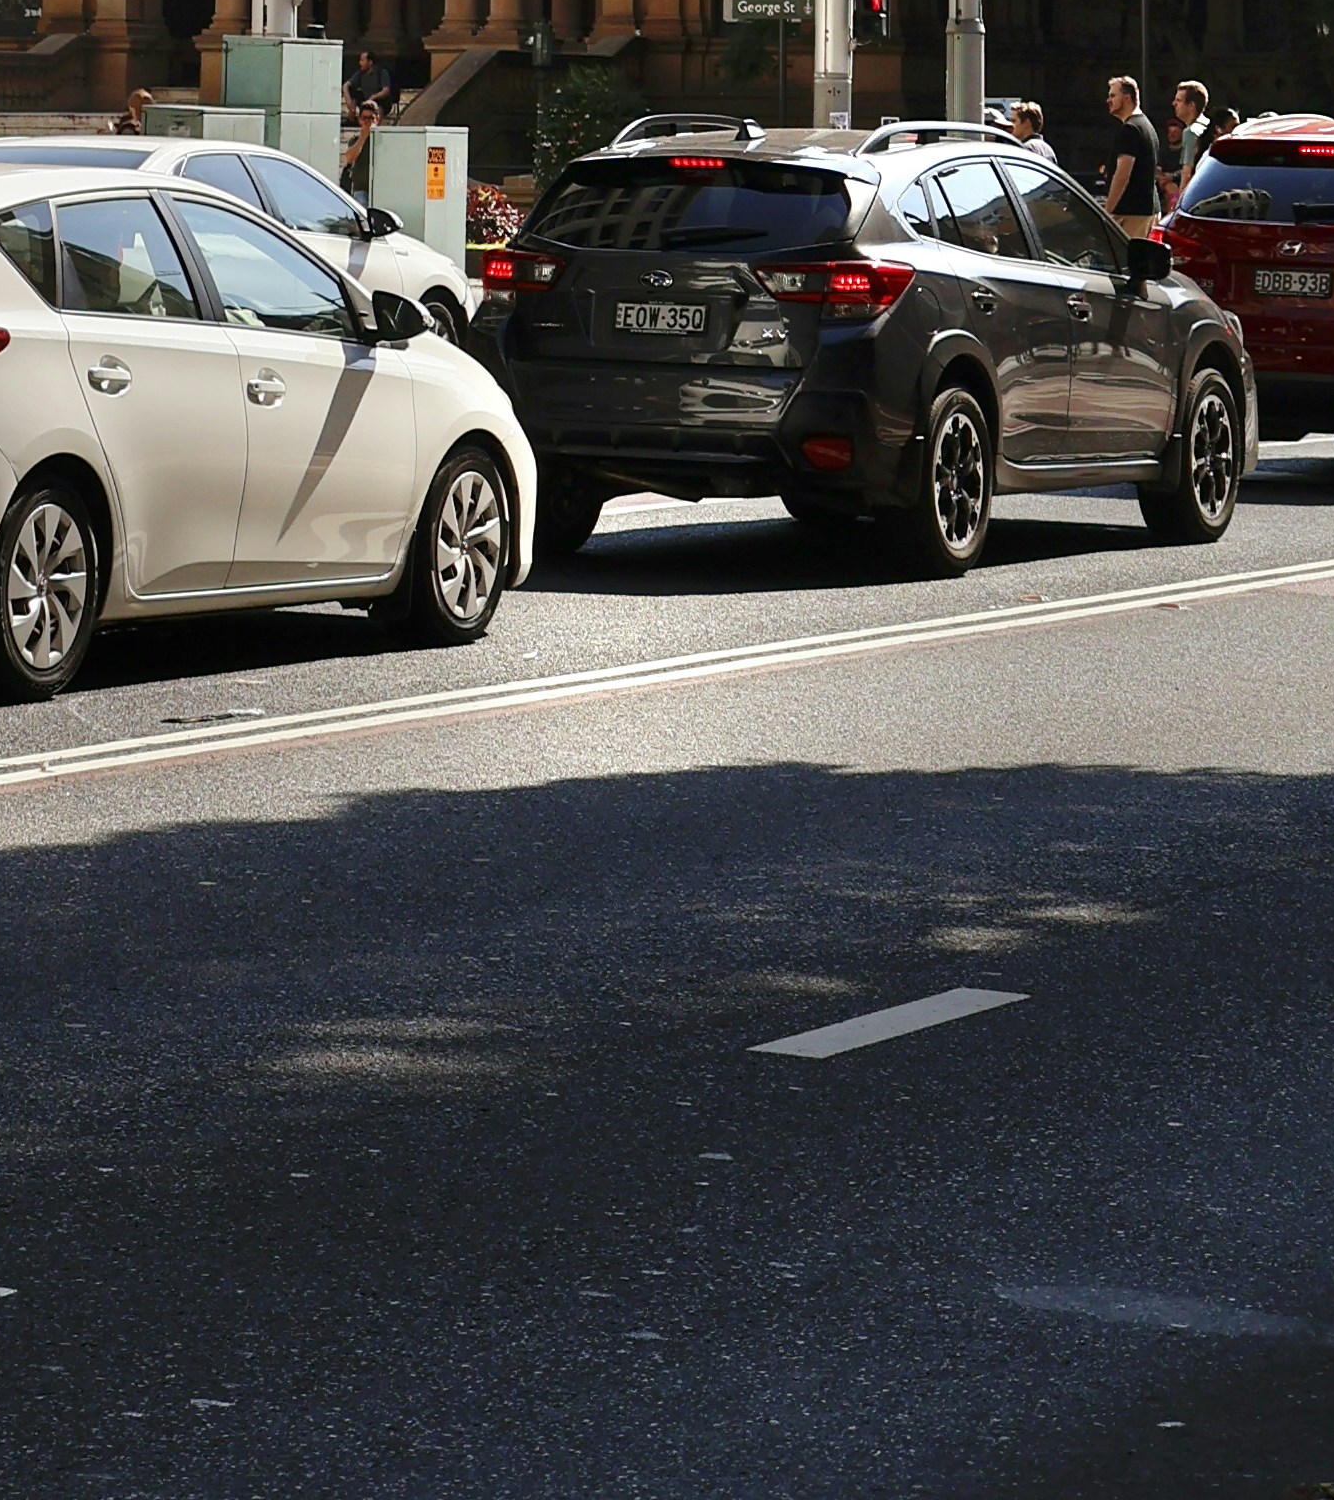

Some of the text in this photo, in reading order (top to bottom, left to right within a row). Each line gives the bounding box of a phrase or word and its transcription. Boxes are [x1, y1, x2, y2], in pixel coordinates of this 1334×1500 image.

[737, 0, 796, 16] George St
[761, 328, 789, 339] XV
